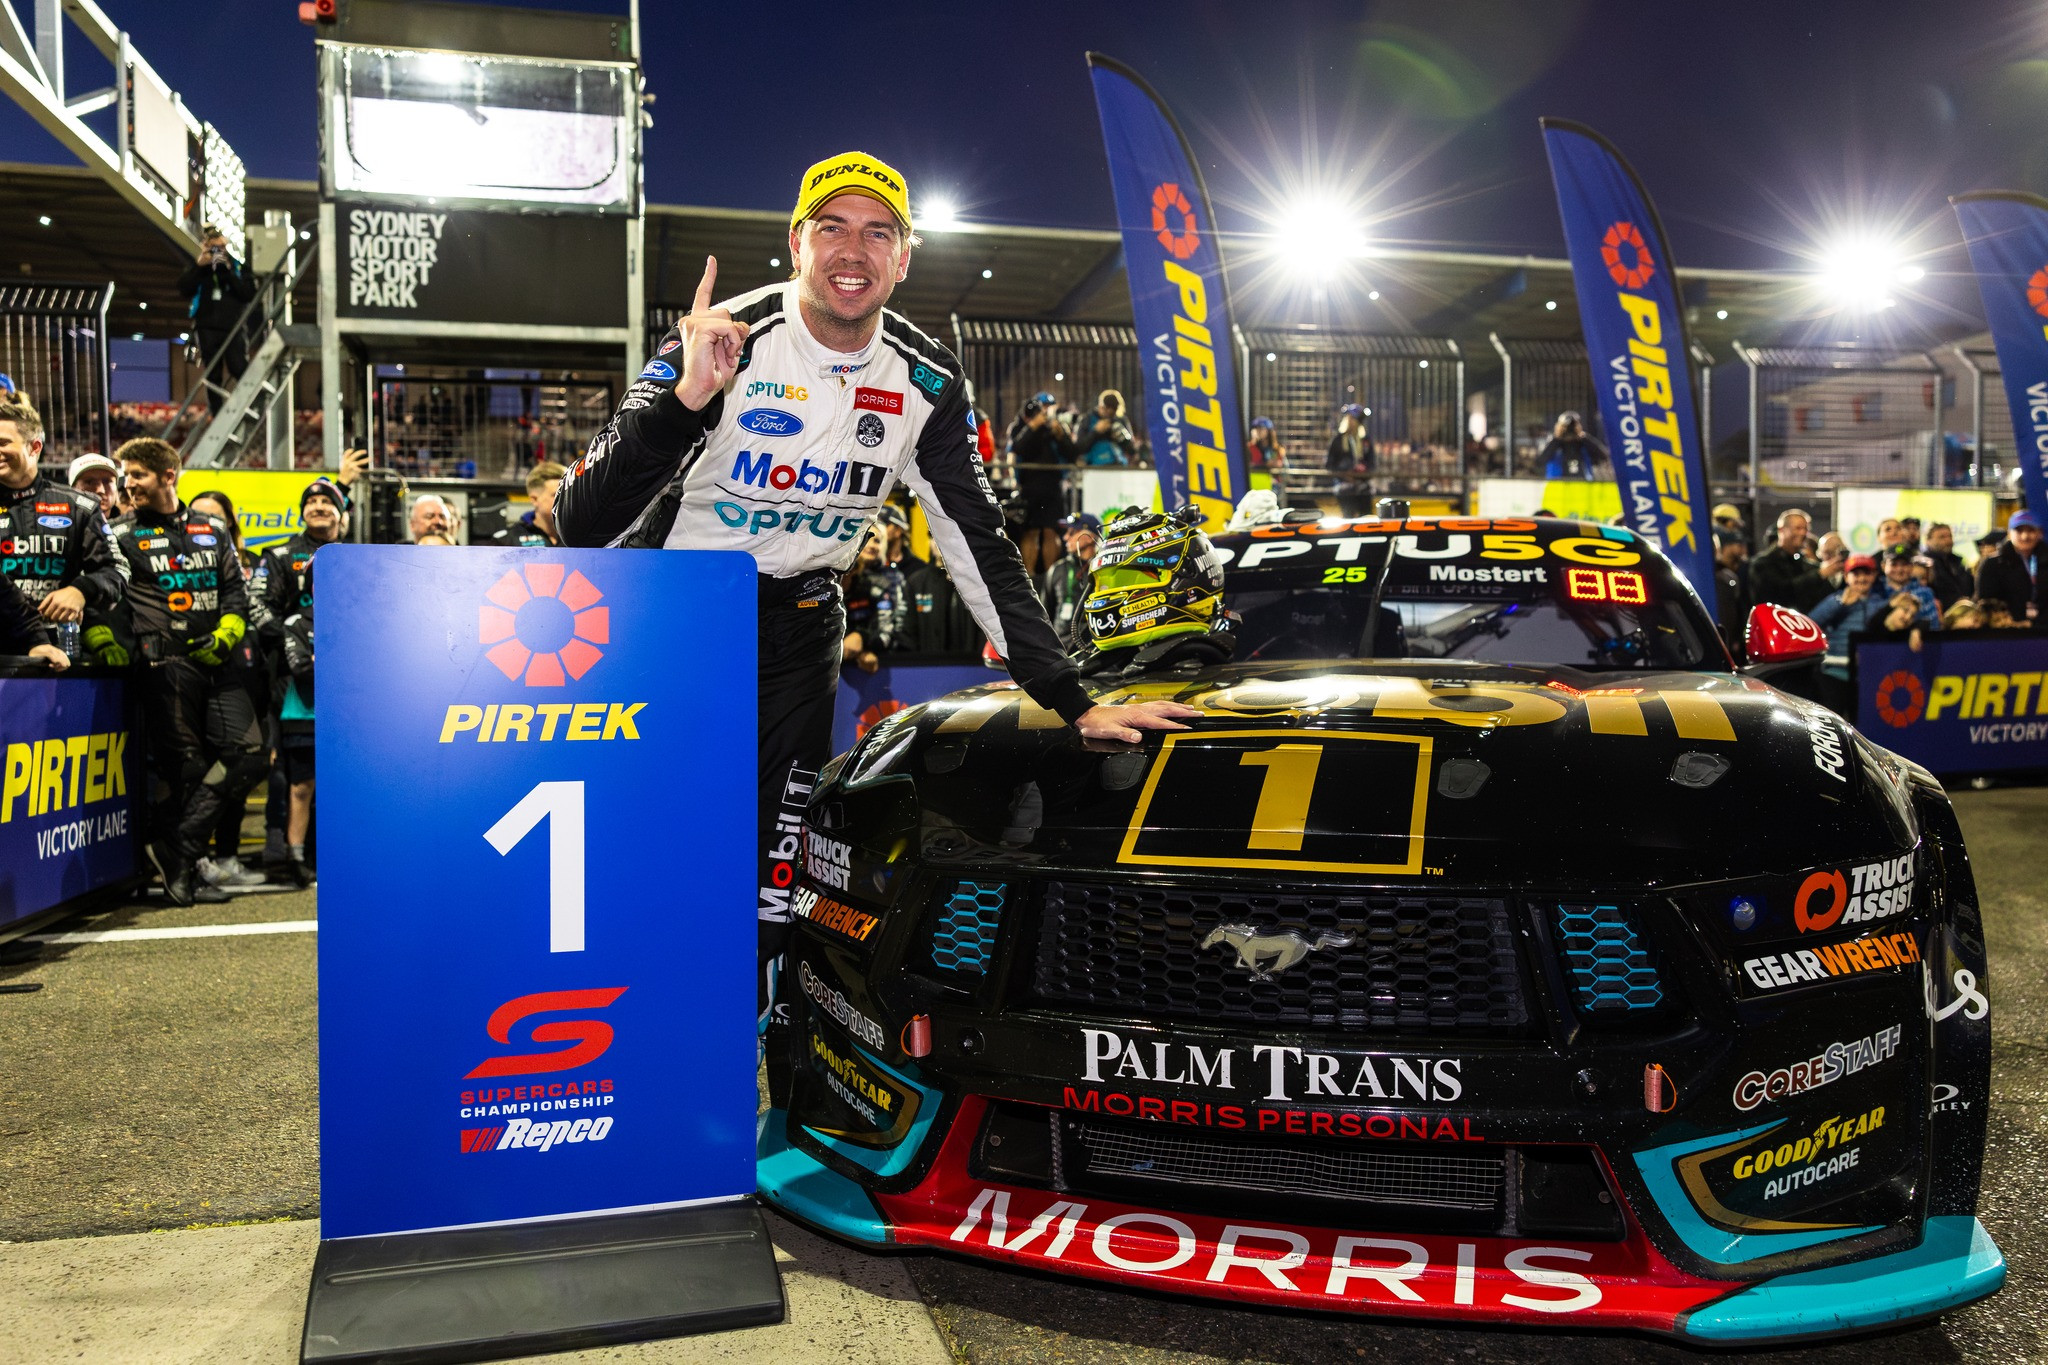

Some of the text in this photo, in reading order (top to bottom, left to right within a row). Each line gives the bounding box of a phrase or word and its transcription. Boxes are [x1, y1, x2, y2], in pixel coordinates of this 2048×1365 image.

[809, 163, 901, 192] DUNLOP
[350, 209, 447, 239] SYDNEY
[350, 234, 438, 262] MOTOR
[350, 258, 433, 286] SPORT
[350, 281, 417, 308] PARK
[746, 381, 809, 401] OPTU5G
[913, 366, 943, 390] OMP
[1153, 333, 1184, 464] VICTORY
[1163, 260, 1236, 534] PIRTEK
[750, 412, 787, 433] Ford
[1610, 355, 1648, 472] VICTORY
[1617, 292, 1697, 554] PIRTEK
[731, 450, 849, 495] Mobil
[714, 501, 866, 542] OPTUS
[0, 535, 40, 555] obil
[1137, 557, 1165, 566] OPTUS
[2, 557, 66, 575] PTUS
[1322, 567, 1367, 584] 25
[1429, 565, 1547, 584] Mostert
[1568, 569, 1647, 603] 88
[1121, 606, 1168, 628] SUPERCHEAP
[438, 702, 649, 743] PIRTEK
[1, 731, 129, 823] PIRTEK
[1239, 743, 1324, 851] 1
[37, 809, 127, 860] VICTORY LANE
[808, 831, 852, 867] TRUCK
[482, 780, 585, 953] 1
[758, 812, 802, 924] Mobil
[807, 856, 851, 892] ASSIST
[1851, 851, 1915, 895] TRUCK
[1841, 881, 1915, 924] ASSIST
[1743, 932, 1921, 989] GEARWRENCH
[813, 1034, 893, 1112] GOODYEAR
[1081, 1028, 1463, 1102] PALM TRANS
[460, 1079, 614, 1105] SUPERCARS
[460, 1095, 614, 1118] CHAMPIONSHIP
[827, 1071, 877, 1126] AUTOCARE
[496, 1116, 614, 1152] Repco
[1063, 1086, 1485, 1141] MORRIS PERSONAL
[1733, 1106, 1885, 1180] GOODYEAR
[1764, 1147, 1860, 1200] AUTOCARE
[950, 1187, 1603, 1313] MORRIS
